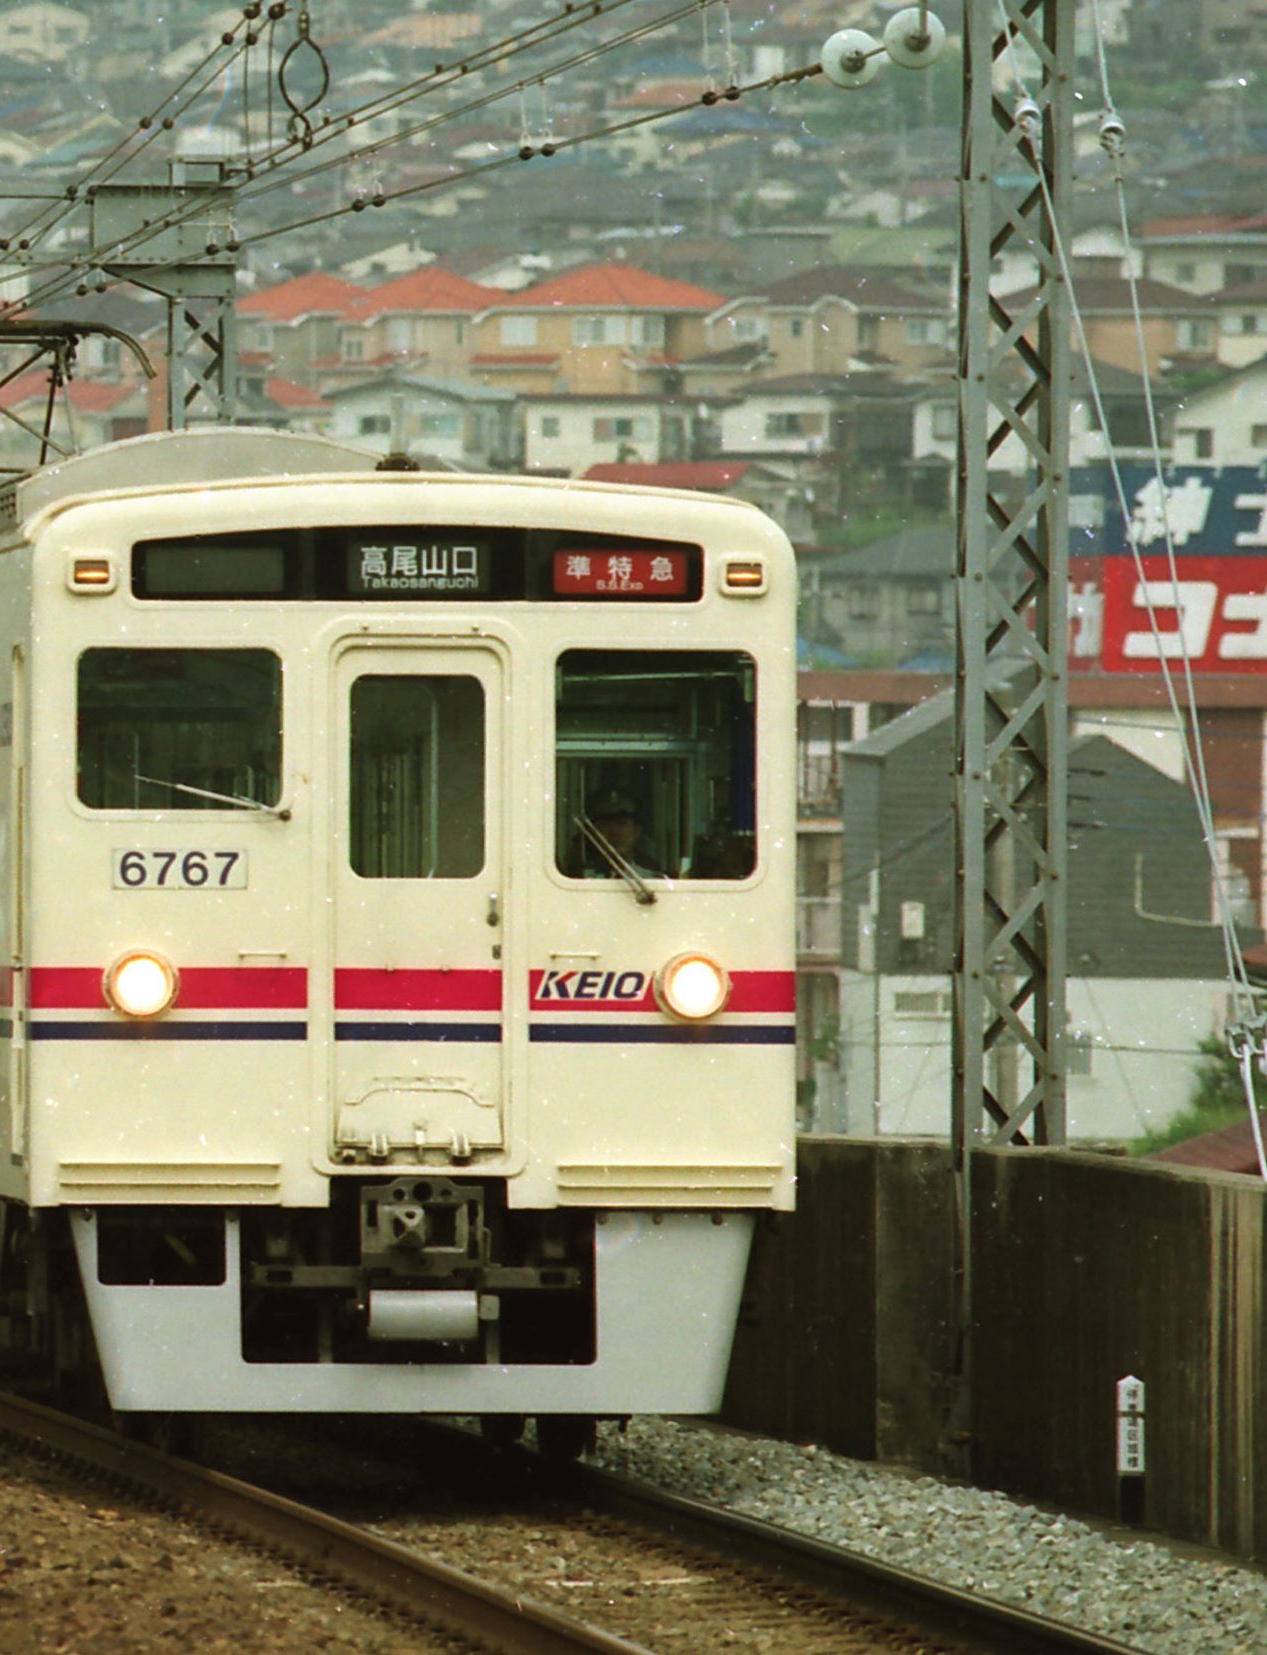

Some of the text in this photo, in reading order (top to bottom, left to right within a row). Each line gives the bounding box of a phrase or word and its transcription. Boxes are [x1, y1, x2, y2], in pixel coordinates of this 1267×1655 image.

[360, 545, 477, 576] 高尾山口
[566, 555, 673, 581] 準特急
[361, 576, 478, 589] Takaosanguchi
[120, 851, 239, 886] 6767
[540, 971, 645, 998] KEIO
